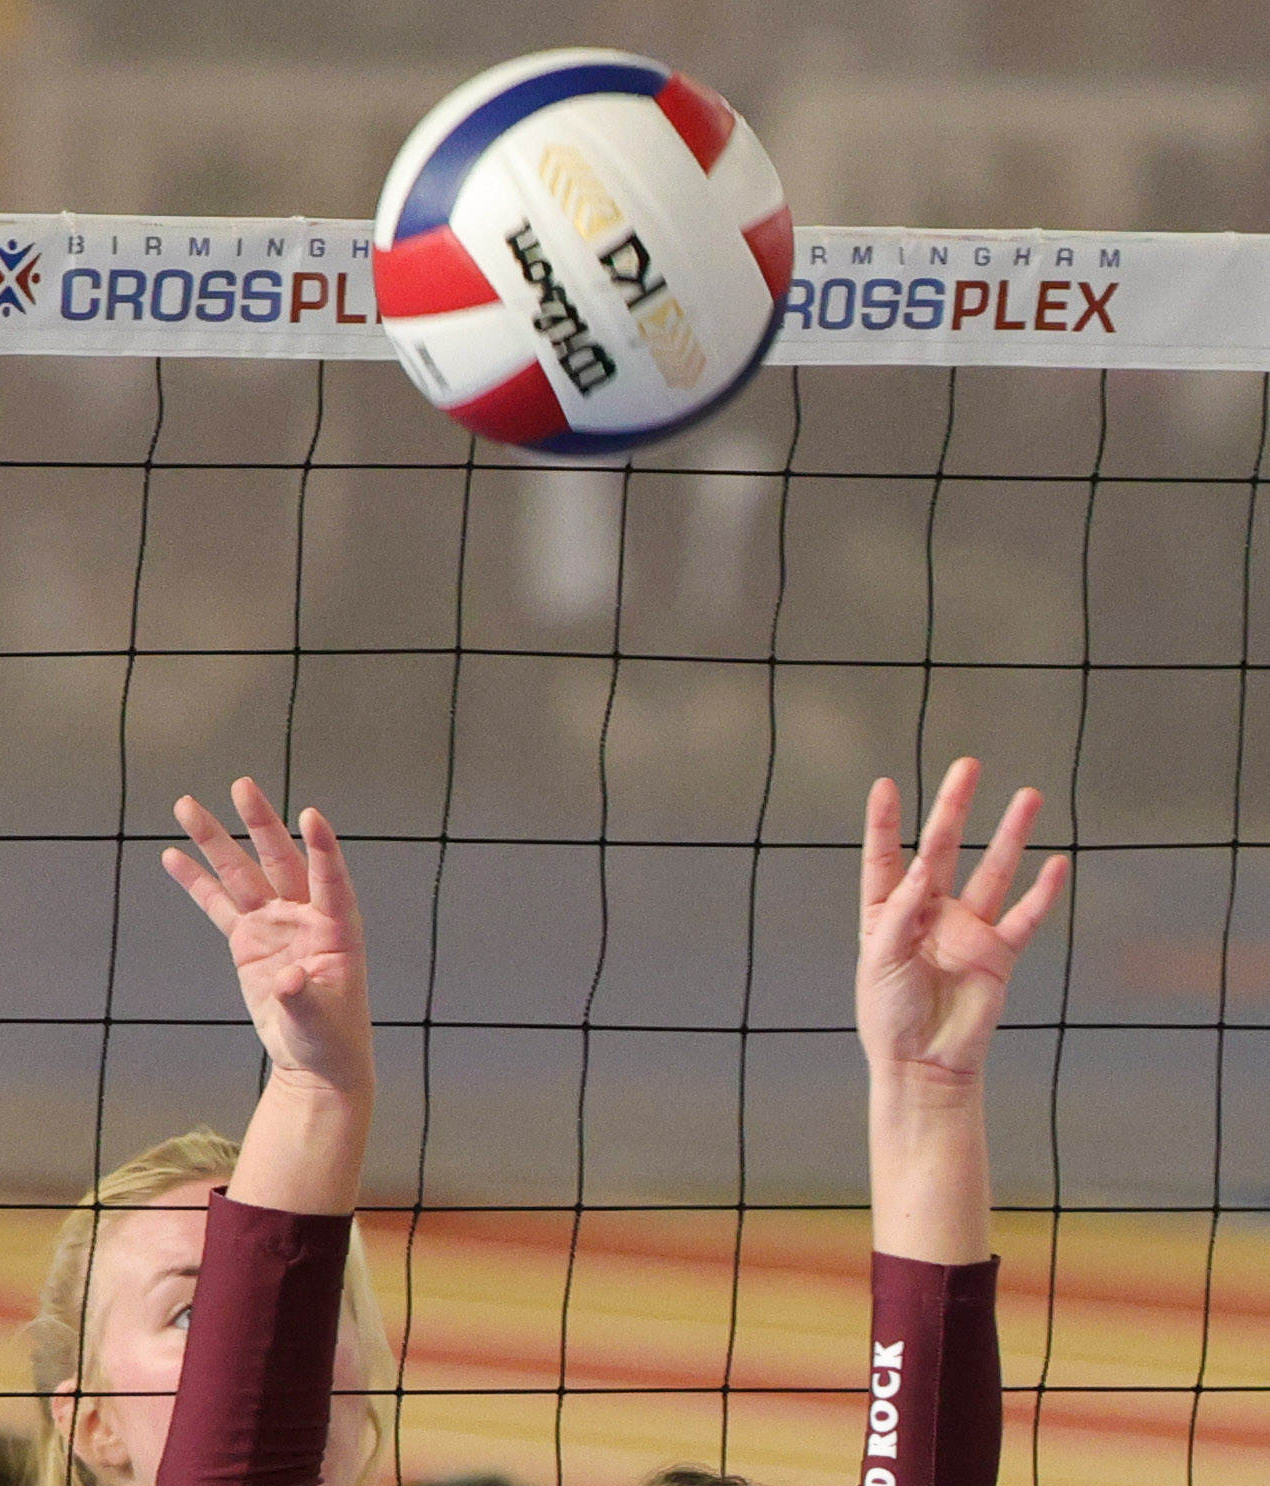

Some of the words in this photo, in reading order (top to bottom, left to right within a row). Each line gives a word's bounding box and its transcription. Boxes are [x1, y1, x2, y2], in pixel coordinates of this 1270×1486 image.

[67, 235, 370, 258] BIRMINGH
[810, 245, 1121, 268] RMINGHAM
[60, 268, 382, 324] CROSSPL
[867, 1340, 905, 1460] ROCK
